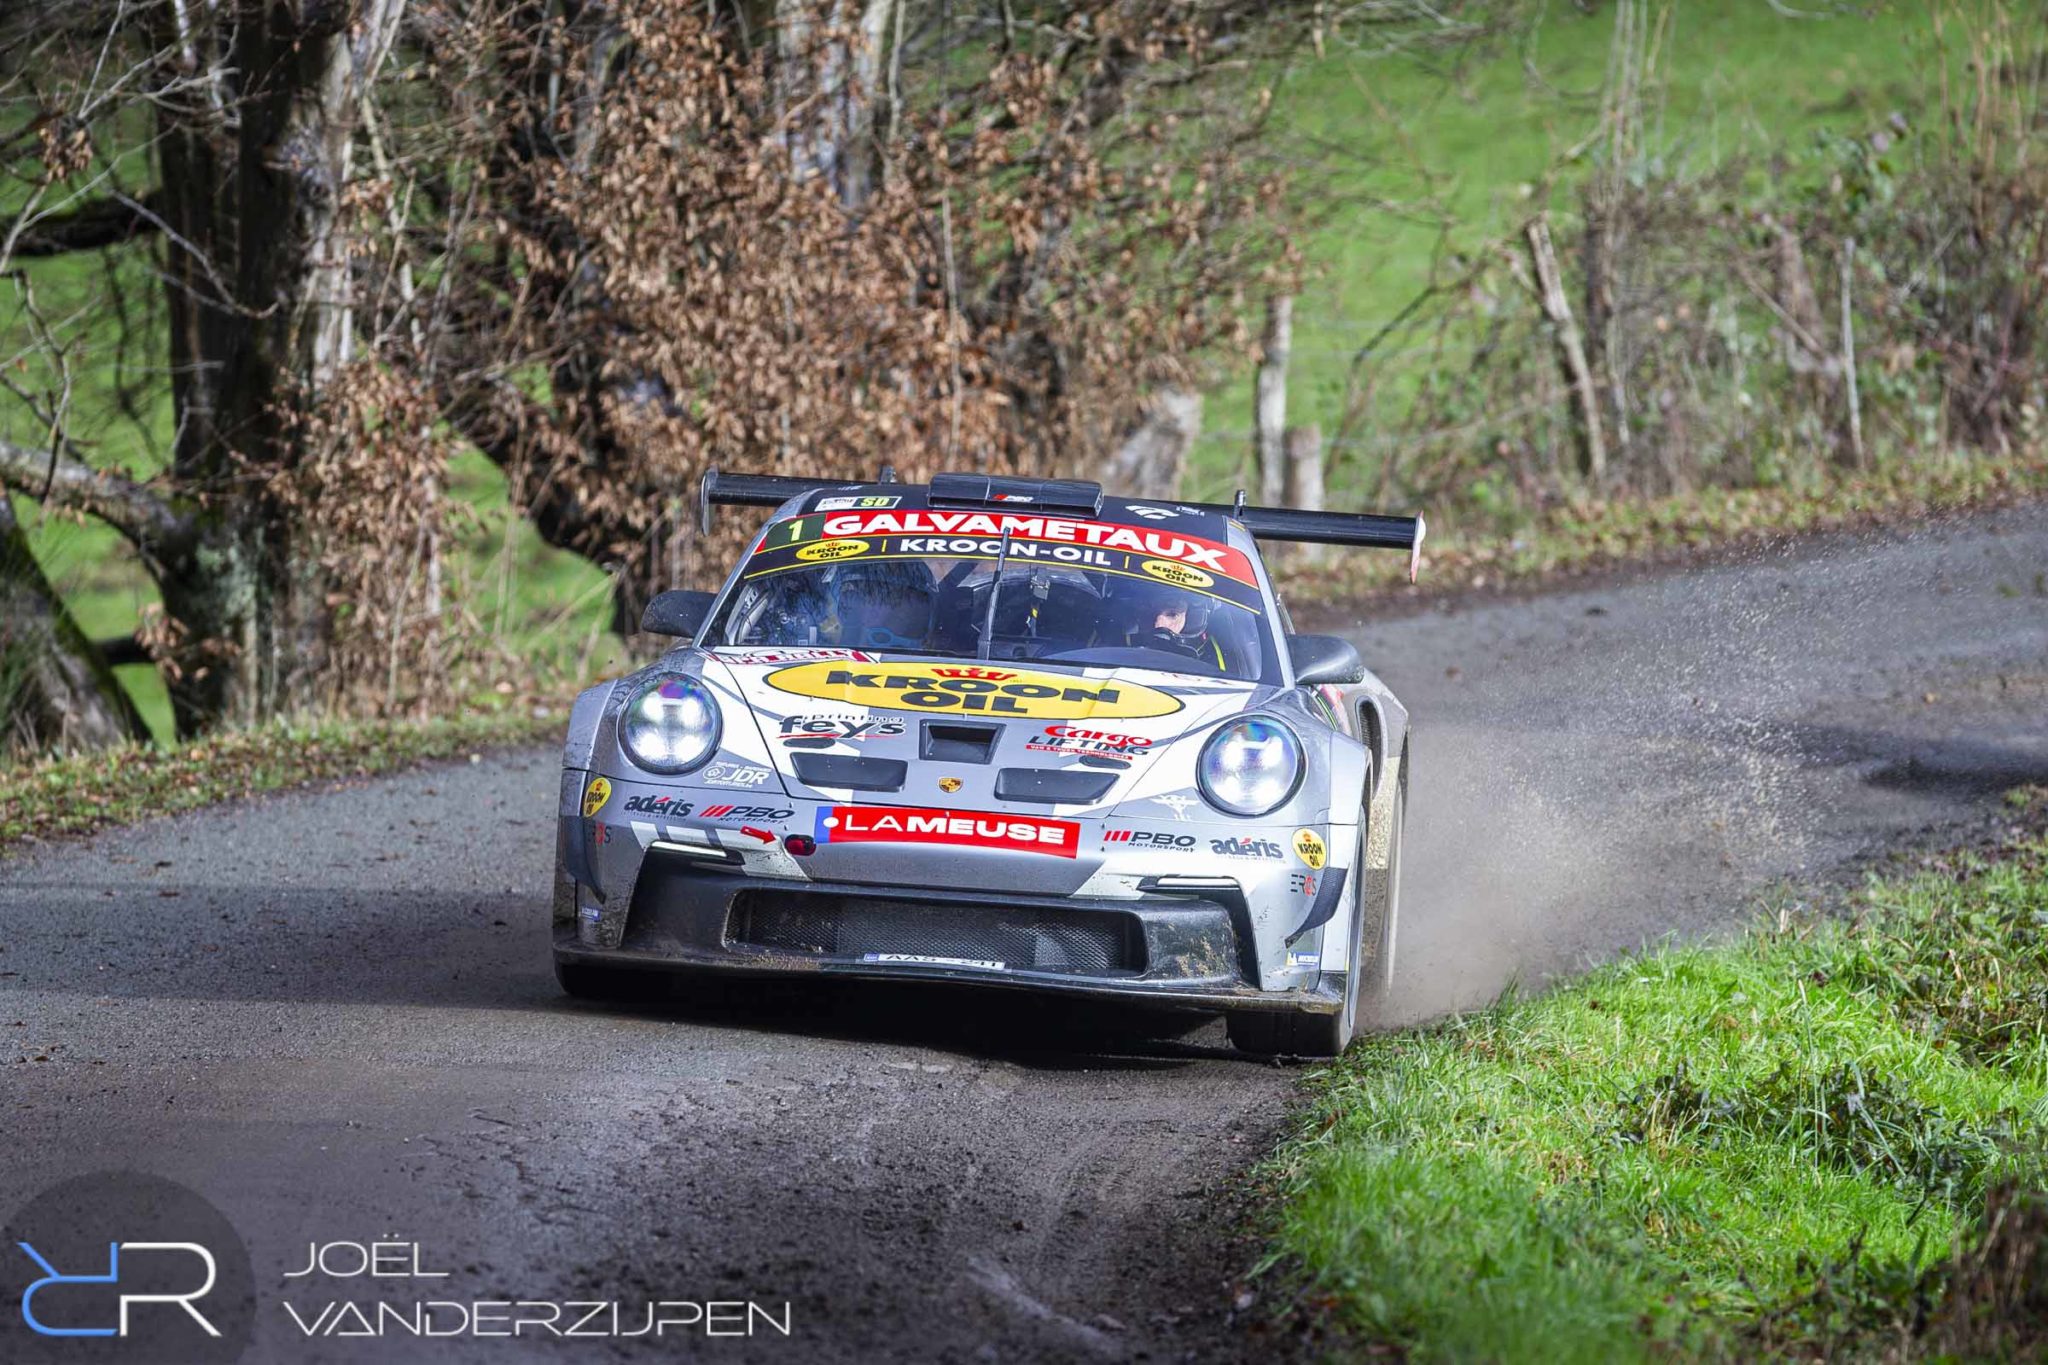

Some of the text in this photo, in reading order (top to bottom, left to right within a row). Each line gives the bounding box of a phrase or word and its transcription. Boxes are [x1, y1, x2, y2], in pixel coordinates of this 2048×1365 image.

[789, 519, 804, 542] 1
[806, 543, 860, 556] KROON
[823, 512, 1227, 573] GALVAMETAUX
[819, 550, 843, 560] OIL
[1151, 564, 1204, 583] KROON
[1165, 573, 1188, 584] OIL
[825, 670, 1121, 704] KROON
[900, 690, 1029, 715] OIL
[778, 714, 905, 739] feys
[1044, 724, 1153, 748] Cargo
[1027, 735, 1151, 756] LIFTING
[721, 767, 770, 785] JDR
[624, 795, 695, 817] adéris
[725, 805, 796, 820] PBO
[718, 816, 785, 826] MOTORSPORT
[1127, 842, 1195, 853] MOTORSPORT
[1131, 831, 1197, 847] PBO
[1209, 836, 1284, 859] adéris
